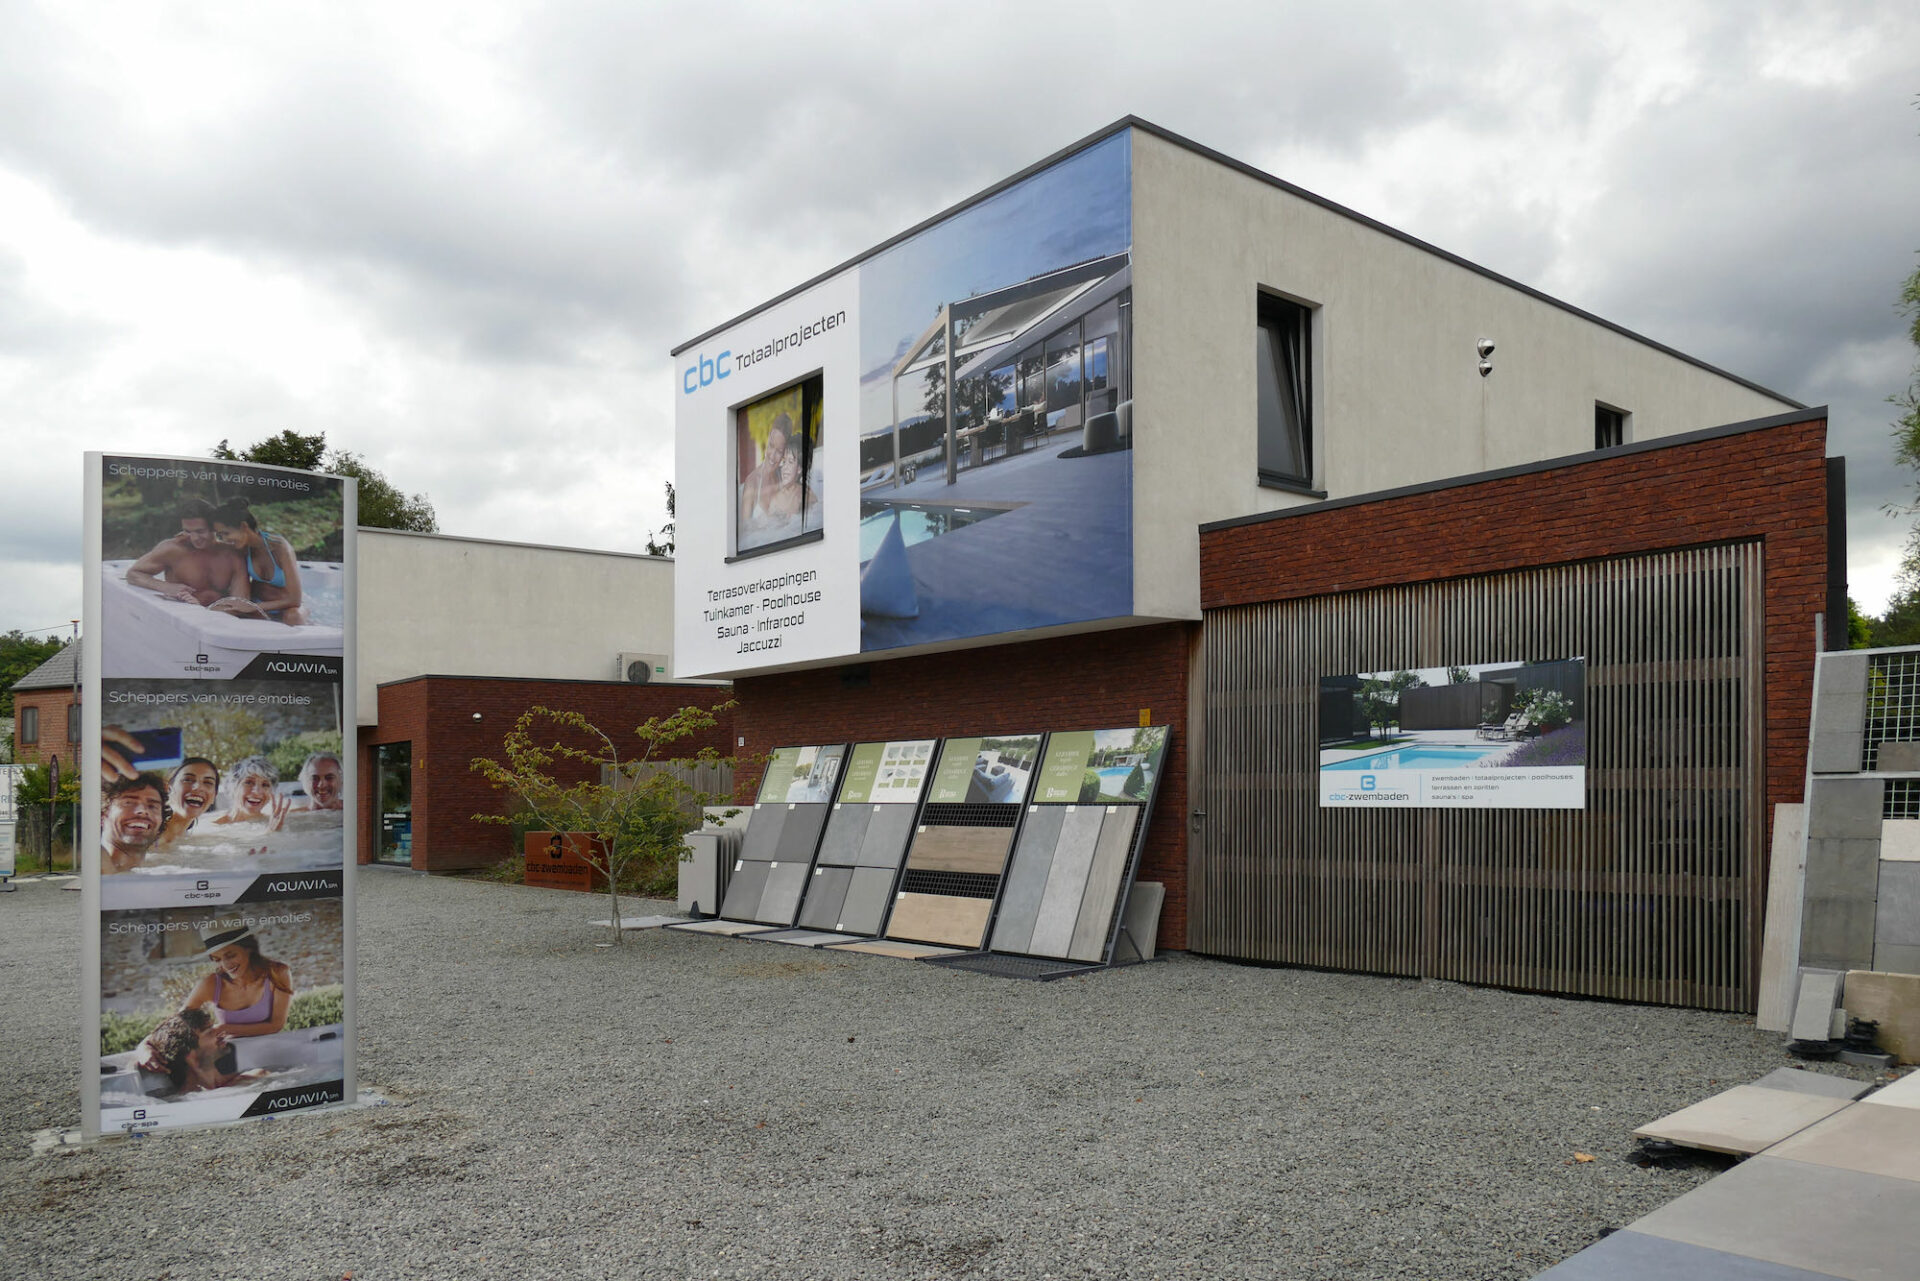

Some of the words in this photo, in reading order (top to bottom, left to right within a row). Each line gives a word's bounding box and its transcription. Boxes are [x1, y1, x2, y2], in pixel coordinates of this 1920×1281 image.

[684, 350, 732, 395] cbc
[735, 310, 846, 371] Totaalprojecten
[109, 463, 188, 480] Scheppers
[191, 470, 217, 481] van
[220, 472, 255, 485] ware
[257, 475, 310, 492] emoties
[707, 569, 817, 602] Terrasoverkappingen
[703, 603, 754, 622] Tuinkamer
[762, 590, 822, 612] Poolhouse
[717, 624, 749, 639] Sauna
[757, 611, 805, 632] Infrarood
[736, 634, 782, 654] Jaccuzzi
[184, 665, 221, 673] cbc-spa
[266, 661, 328, 674] AQUAVIA
[109, 691, 188, 704] Scheppers
[191, 694, 217, 703] van
[220, 694, 255, 704] ware
[257, 692, 311, 705] emoties
[1328, 792, 1410, 801] cbc-zwembaden
[184, 892, 222, 900] cbc-spa
[266, 879, 328, 893] AQUAVIA
[109, 920, 189, 935] Scheppers
[192, 919, 218, 930] van
[221, 917, 256, 928] ware
[258, 912, 312, 926] emoties
[267, 1090, 330, 1110] AQUAVIA
